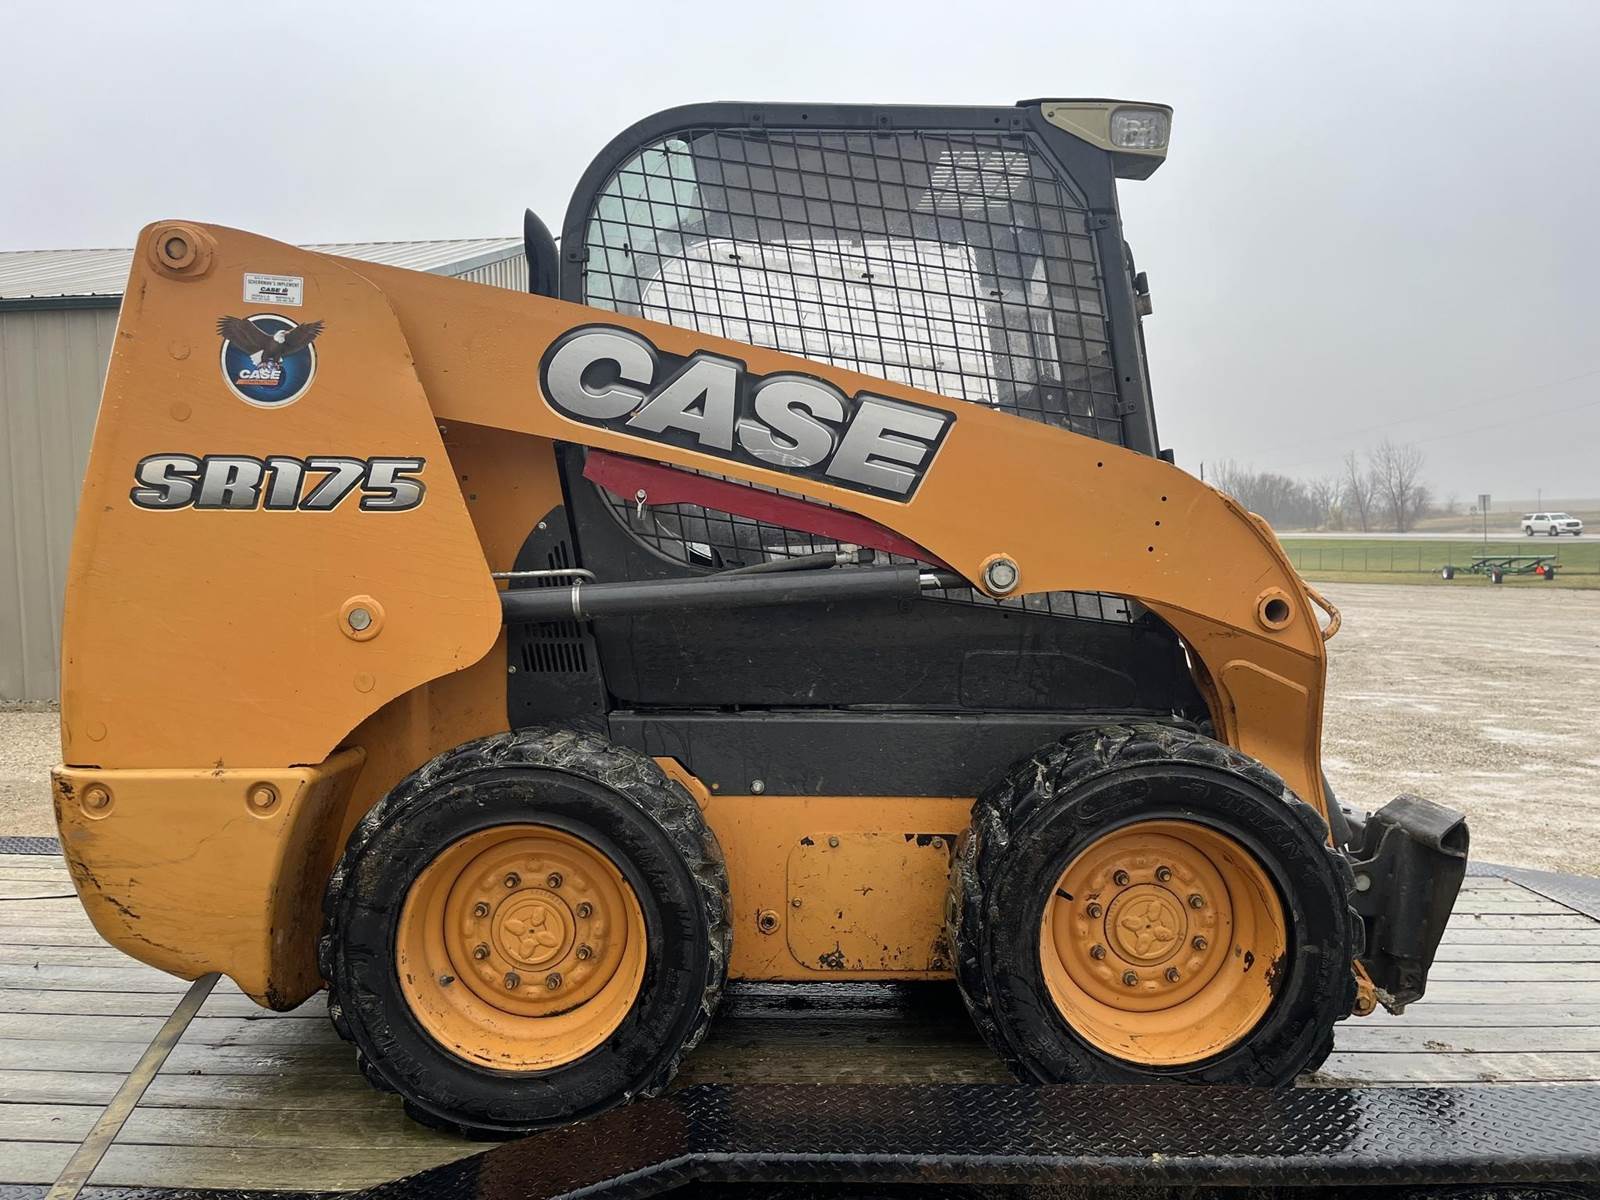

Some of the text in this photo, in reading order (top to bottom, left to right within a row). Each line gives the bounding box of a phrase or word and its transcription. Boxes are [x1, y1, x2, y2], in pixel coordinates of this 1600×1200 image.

[239, 369, 281, 380] CASE
[540, 325, 954, 503] CASE
[130, 453, 426, 511] SR175
